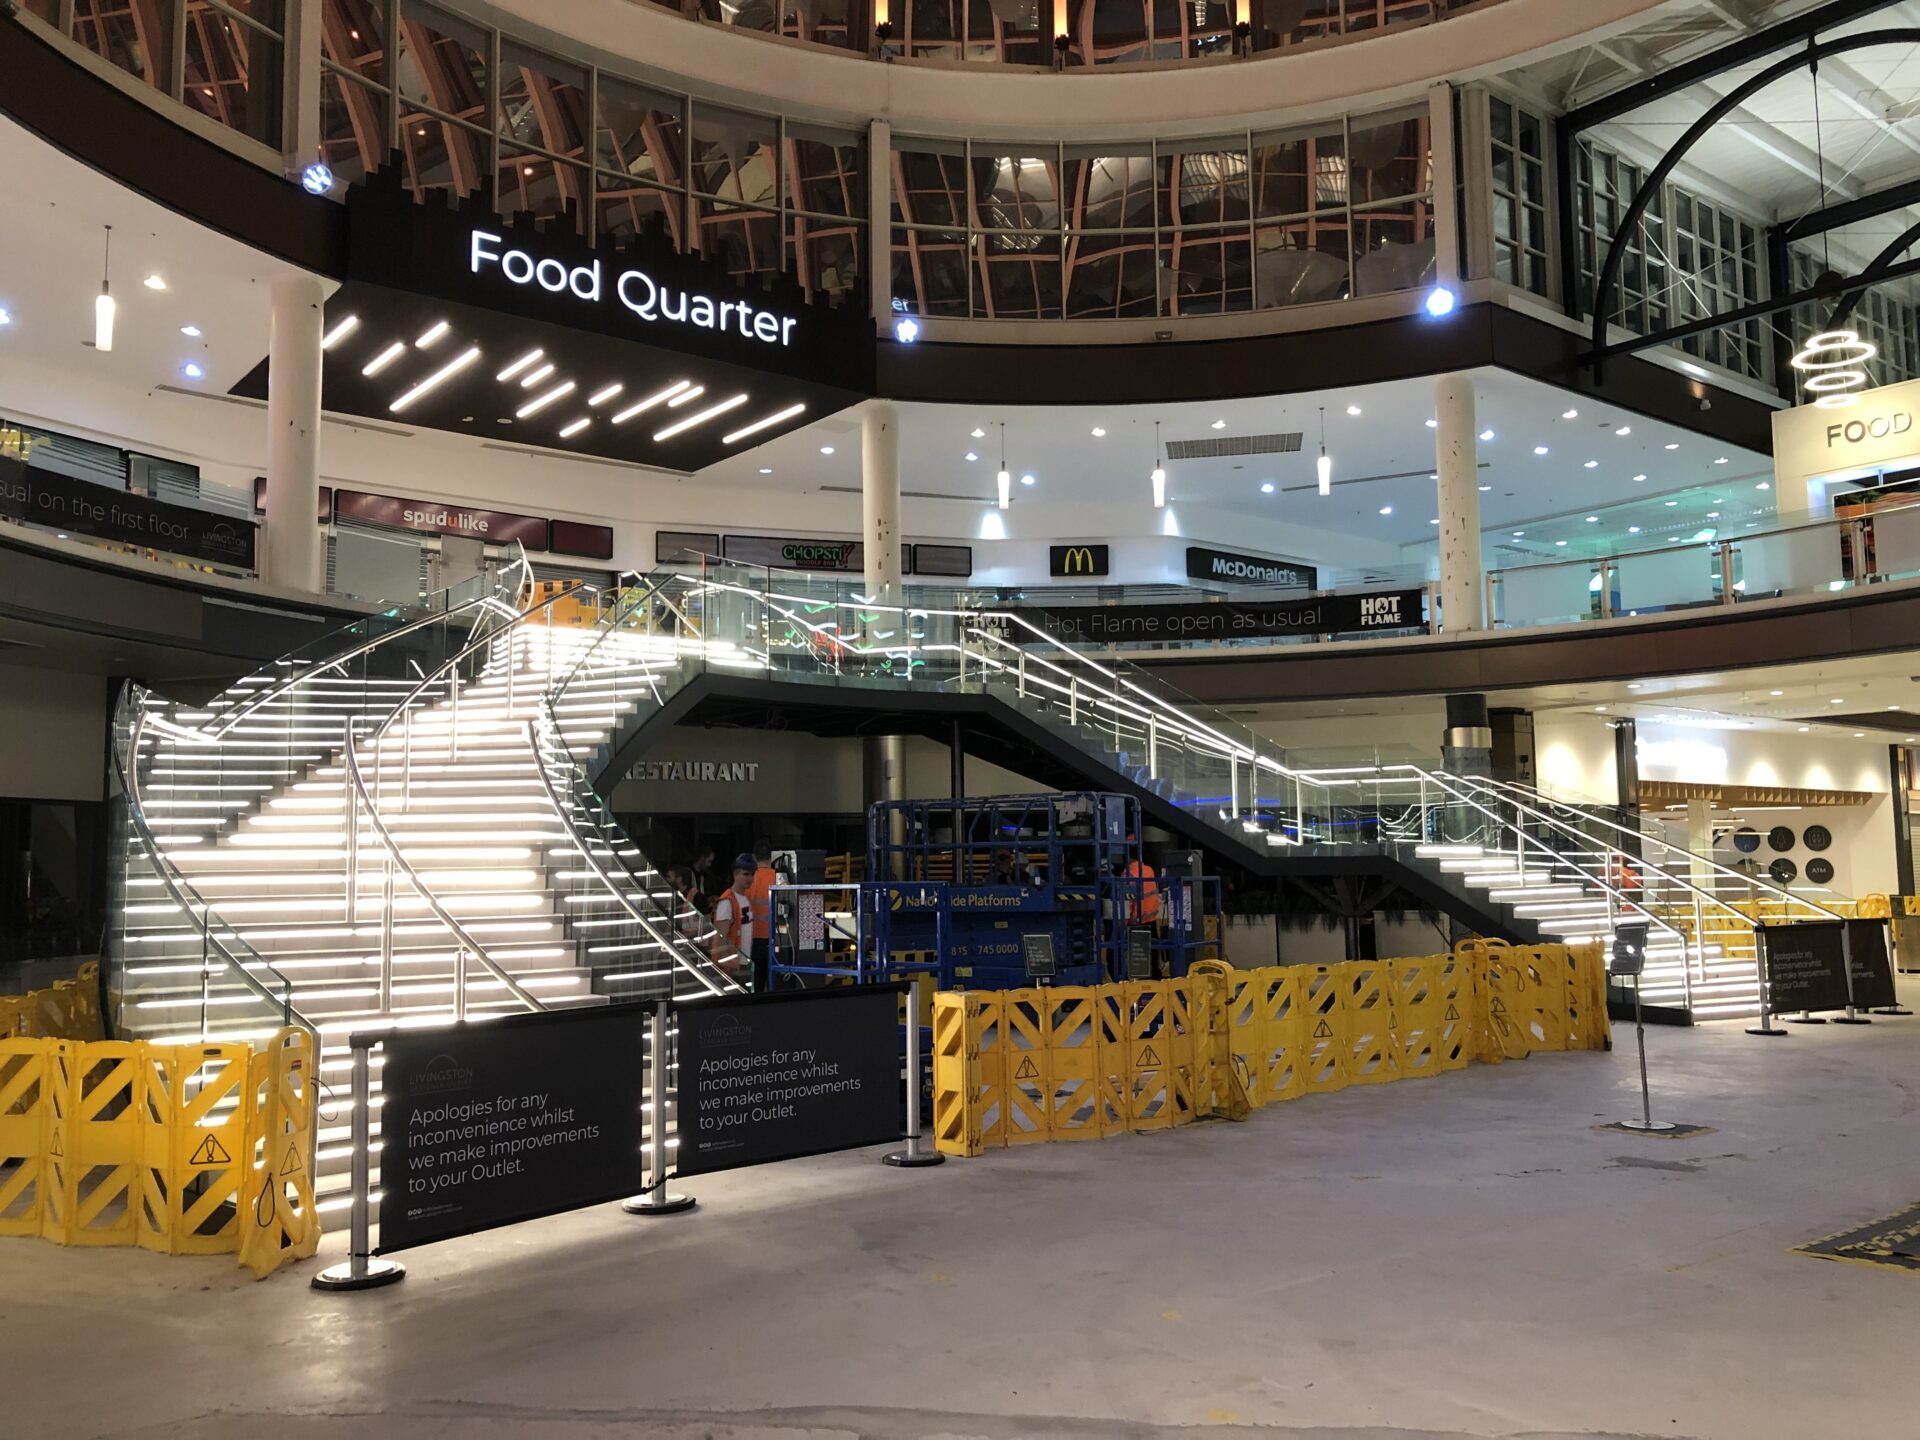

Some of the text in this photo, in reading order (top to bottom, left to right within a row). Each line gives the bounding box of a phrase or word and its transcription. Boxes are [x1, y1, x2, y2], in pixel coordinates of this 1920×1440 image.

[471, 230, 797, 346] Food Quarter
[1826, 412, 1913, 448] FOOD
[38, 492, 65, 512] on
[72, 496, 105, 521] the
[111, 504, 144, 530] first
[149, 513, 190, 540] floor
[403, 509, 489, 532] spudulike
[1211, 557, 1298, 585] McDonald's
[1044, 606, 1322, 634] Hot Flame open as usual
[1360, 596, 1401, 616] HOT
[1360, 613, 1401, 626] FLAME
[968, 894, 1021, 907] Platforms
[996, 939, 1019, 954] 0000
[700, 1049, 817, 1075] Apologies for any
[699, 1062, 839, 1092] inconvenience whilst
[700, 1077, 861, 1111] we make improvements
[409, 1092, 549, 1126] Apologies for any
[699, 1104, 797, 1130] to your Outlet.
[408, 1107, 575, 1148] inconvenience whilst
[408, 1124, 599, 1171] we make improvements
[408, 1158, 525, 1193] to your Outlet.
